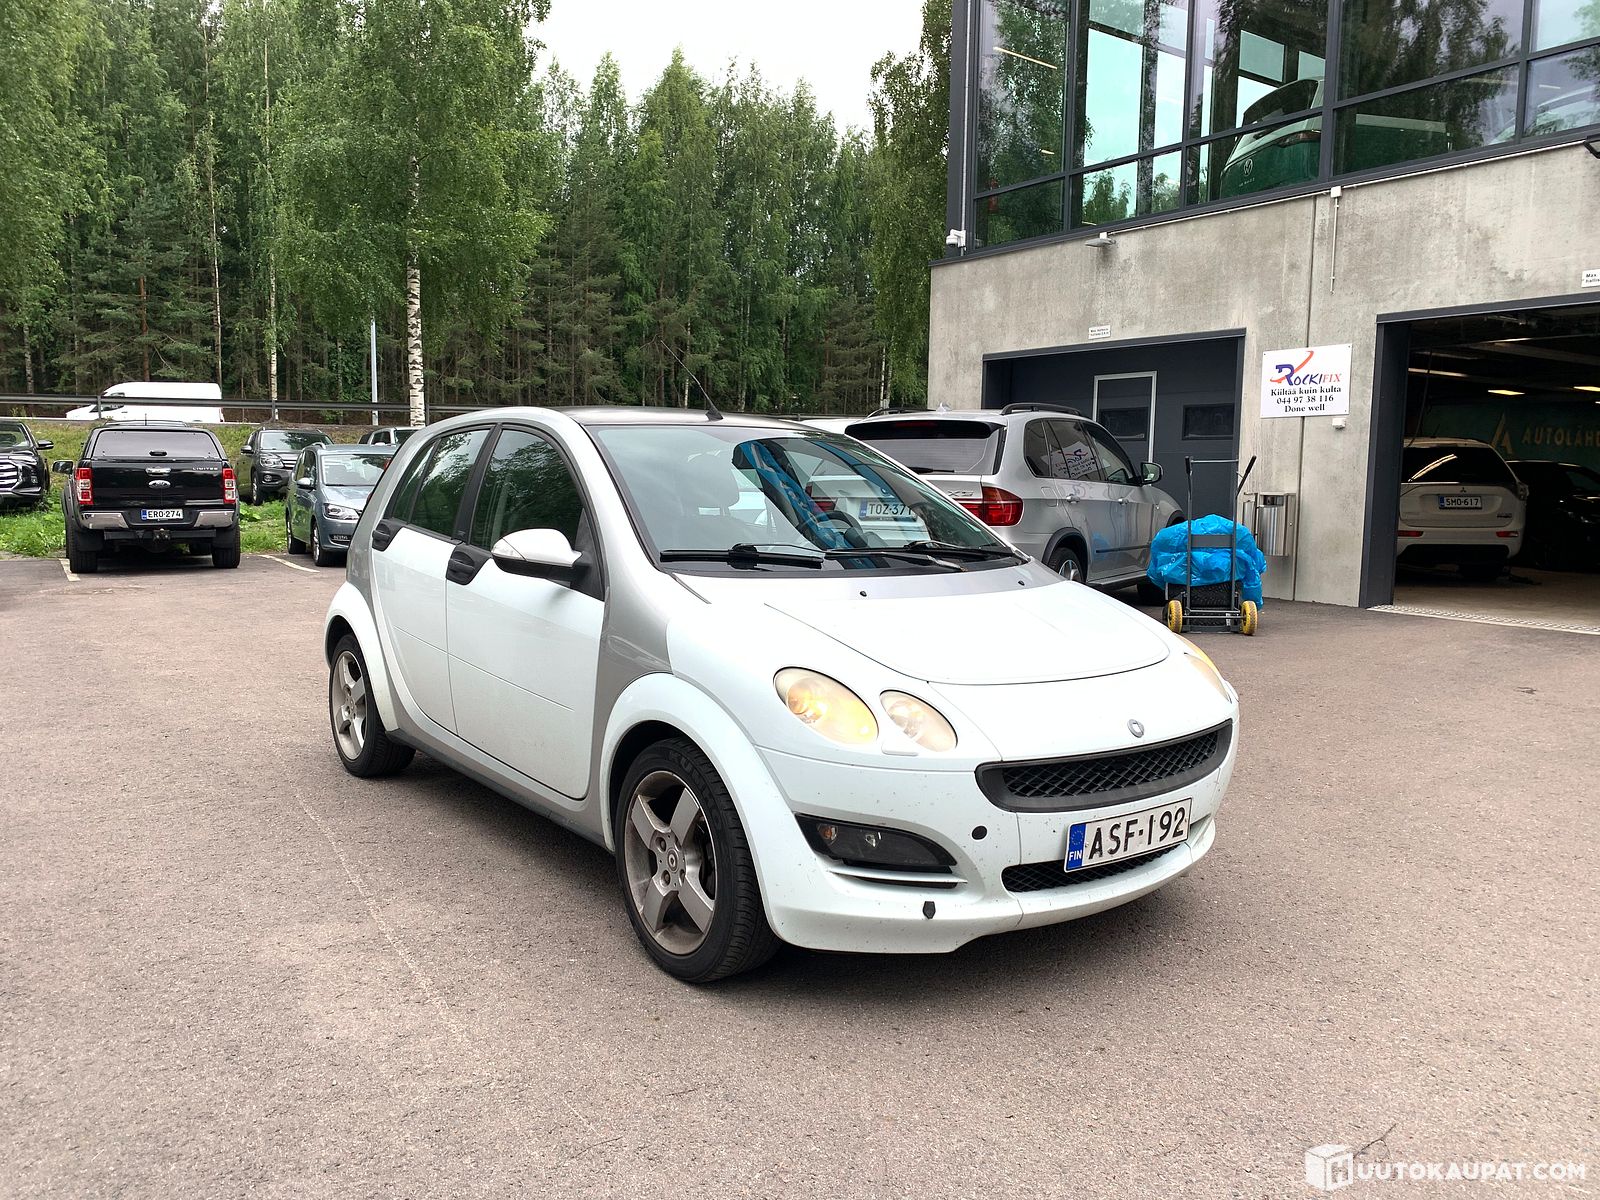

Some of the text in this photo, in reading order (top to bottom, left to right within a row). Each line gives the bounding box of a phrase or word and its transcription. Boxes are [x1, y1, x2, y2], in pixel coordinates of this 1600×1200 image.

[1271, 385, 1342, 397] Kiiltää kuin kulta
[1276, 394, 1334, 405] 044 97 38 116
[1284, 403, 1325, 413] Done well
[1069, 807, 1186, 861] FIN ASF-192
